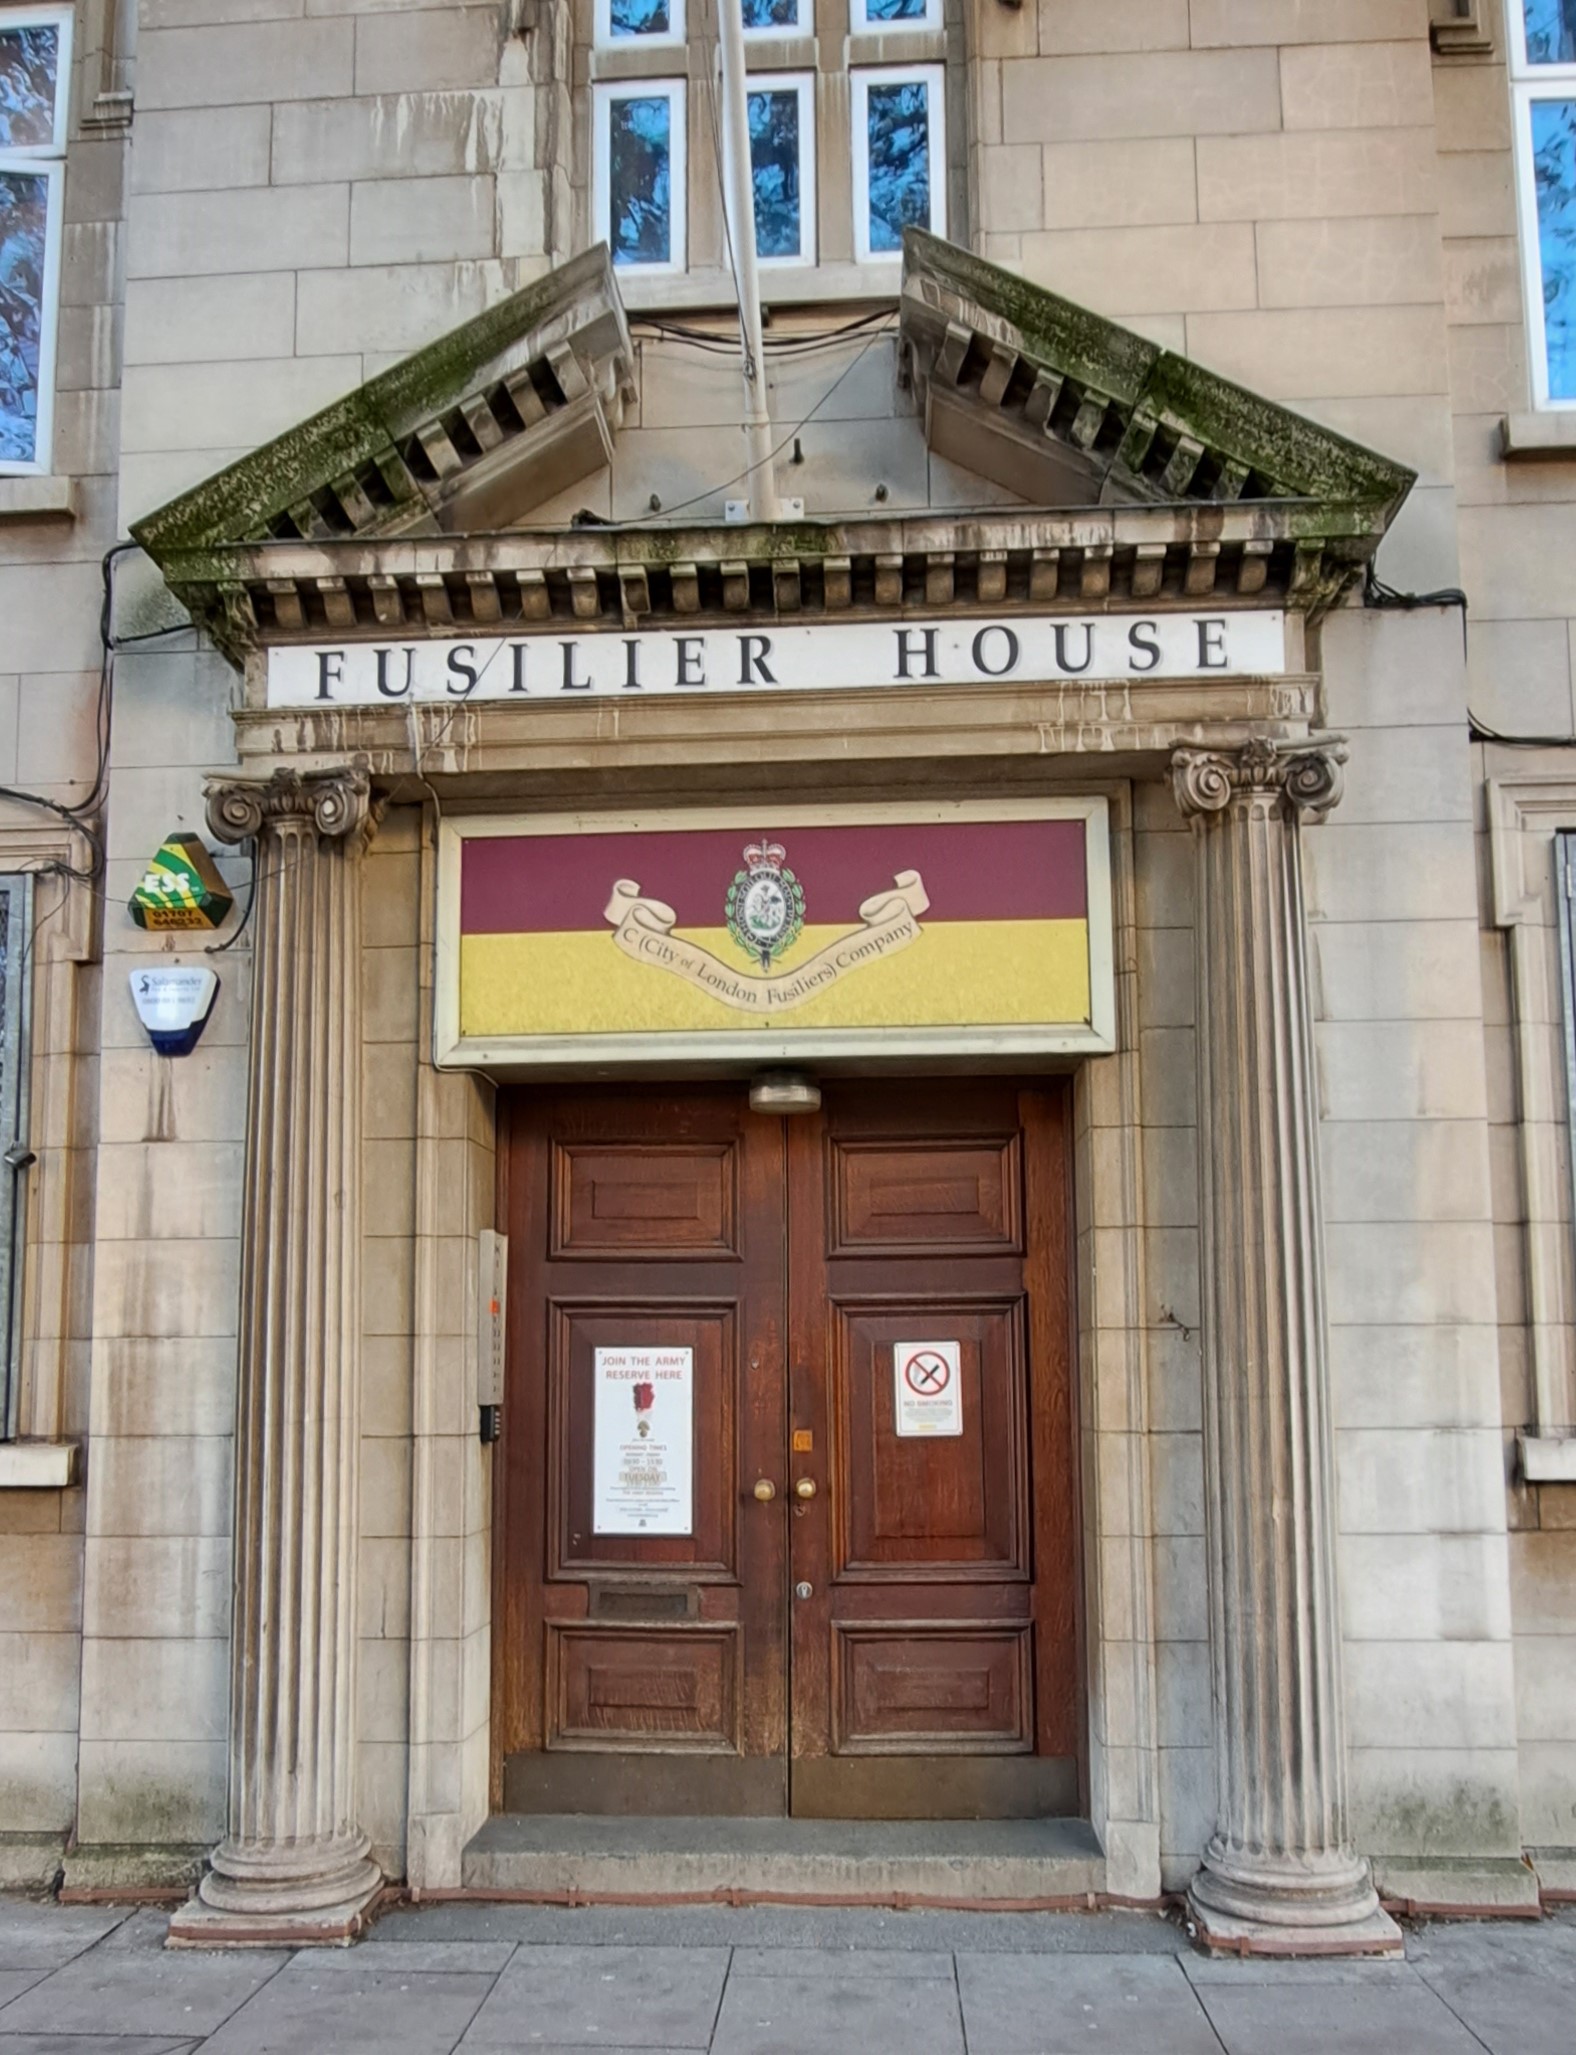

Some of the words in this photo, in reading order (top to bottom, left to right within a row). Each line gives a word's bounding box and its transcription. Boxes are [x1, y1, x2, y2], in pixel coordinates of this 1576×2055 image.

[314, 634, 779, 701] FUSILIER
[892, 618, 1230, 679] HOUSE
[143, 872, 190, 894] ESS
[622, 927, 640, 944] C
[638, 934, 679, 965] (City
[680, 957, 695, 970] of
[696, 962, 758, 1004] London
[766, 962, 838, 1005] Fusiliers)
[834, 921, 914, 969] Company
[602, 1356, 626, 1366] JOIN
[630, 1356, 650, 1366] THE
[655, 1356, 686, 1366] ARMY
[605, 1370, 650, 1380] RESERVE
[655, 1370, 683, 1380] HERE
